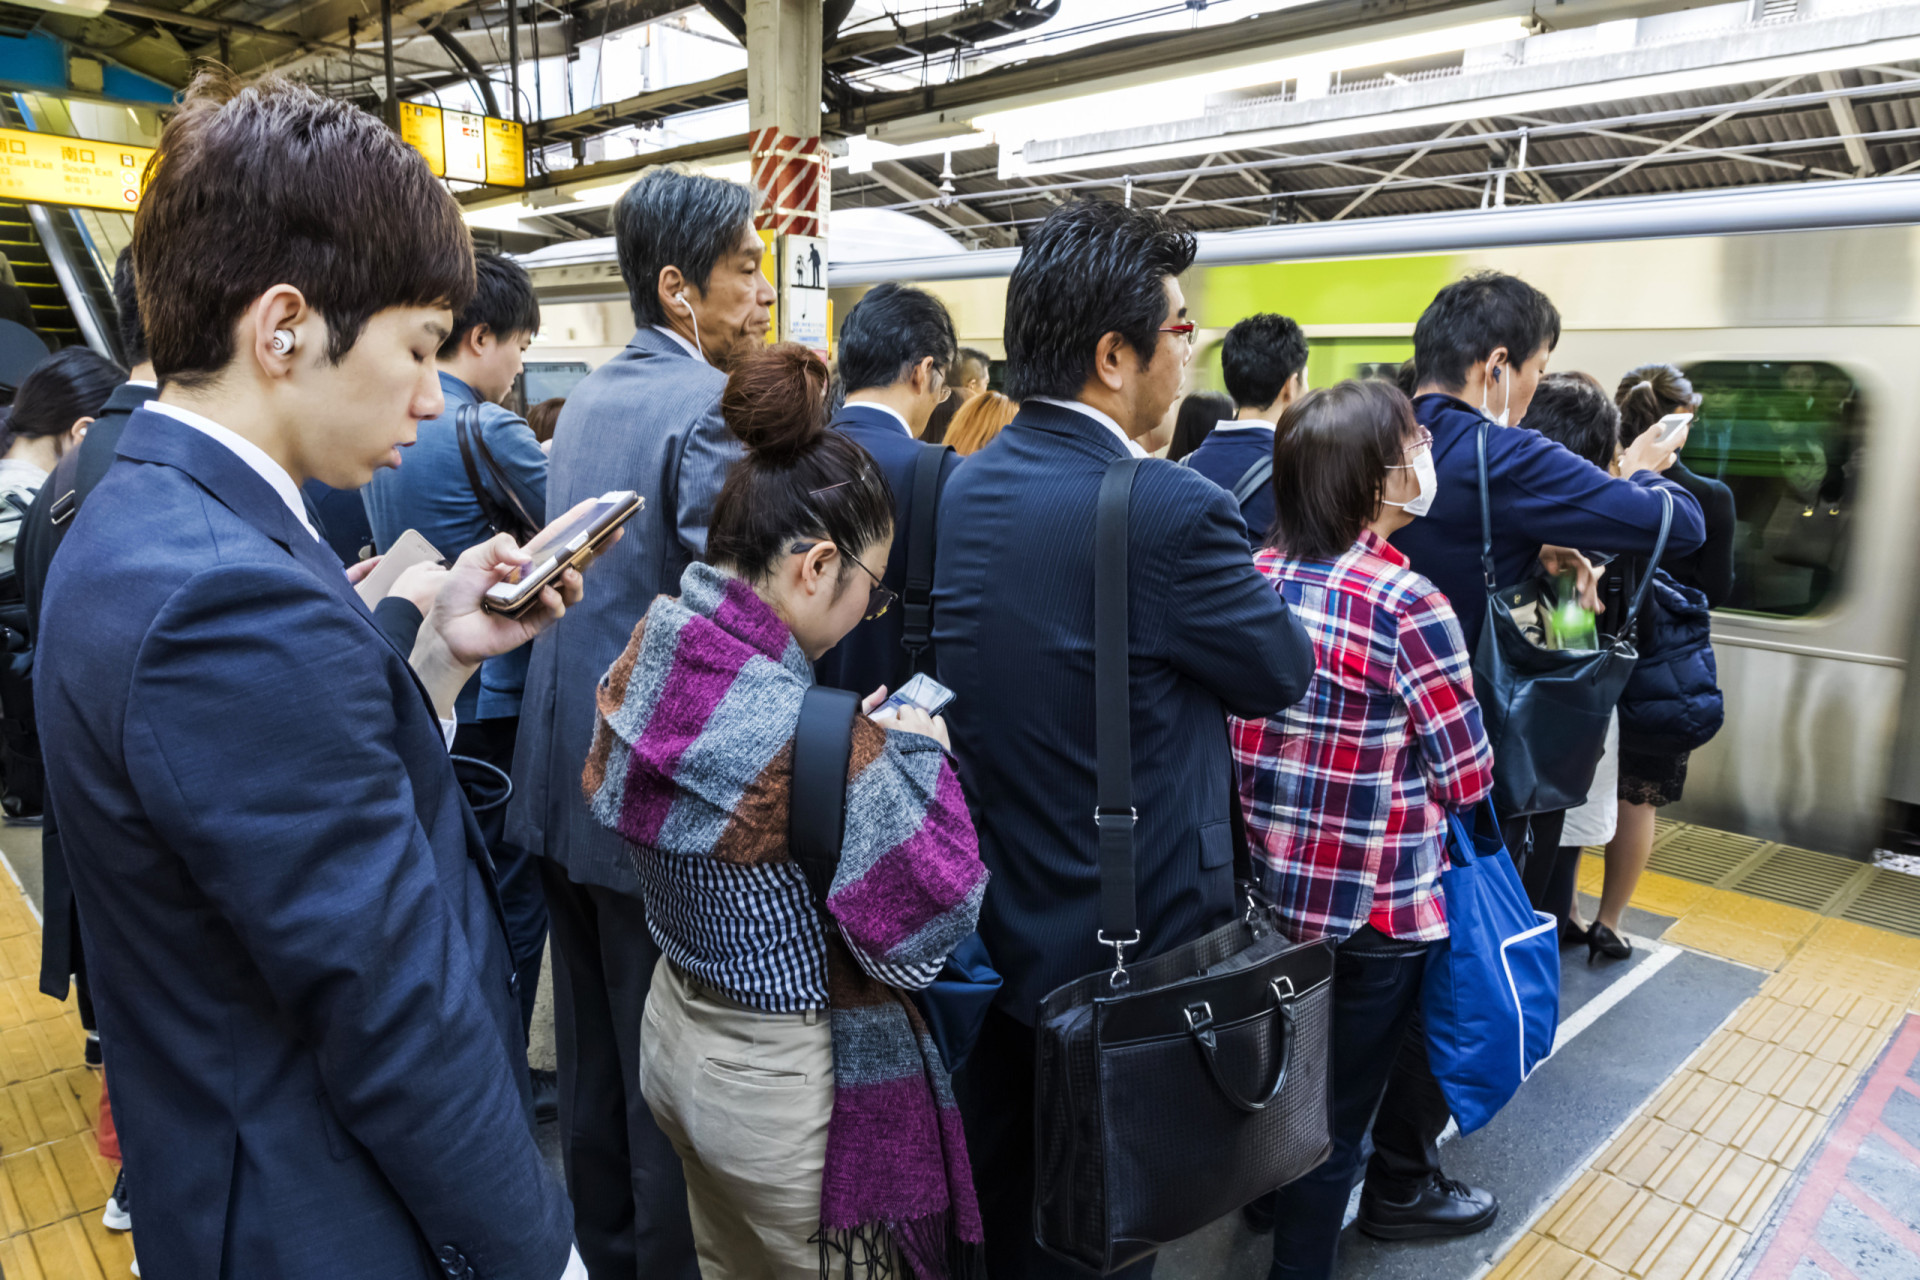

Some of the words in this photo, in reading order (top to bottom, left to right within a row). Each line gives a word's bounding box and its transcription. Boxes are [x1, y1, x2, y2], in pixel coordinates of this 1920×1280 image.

[61, 146, 96, 164] 南口
[7, 156, 31, 168] East
[34, 159, 54, 170] Exit
[63, 163, 92, 175] South
[95, 167, 113, 177] Exit
